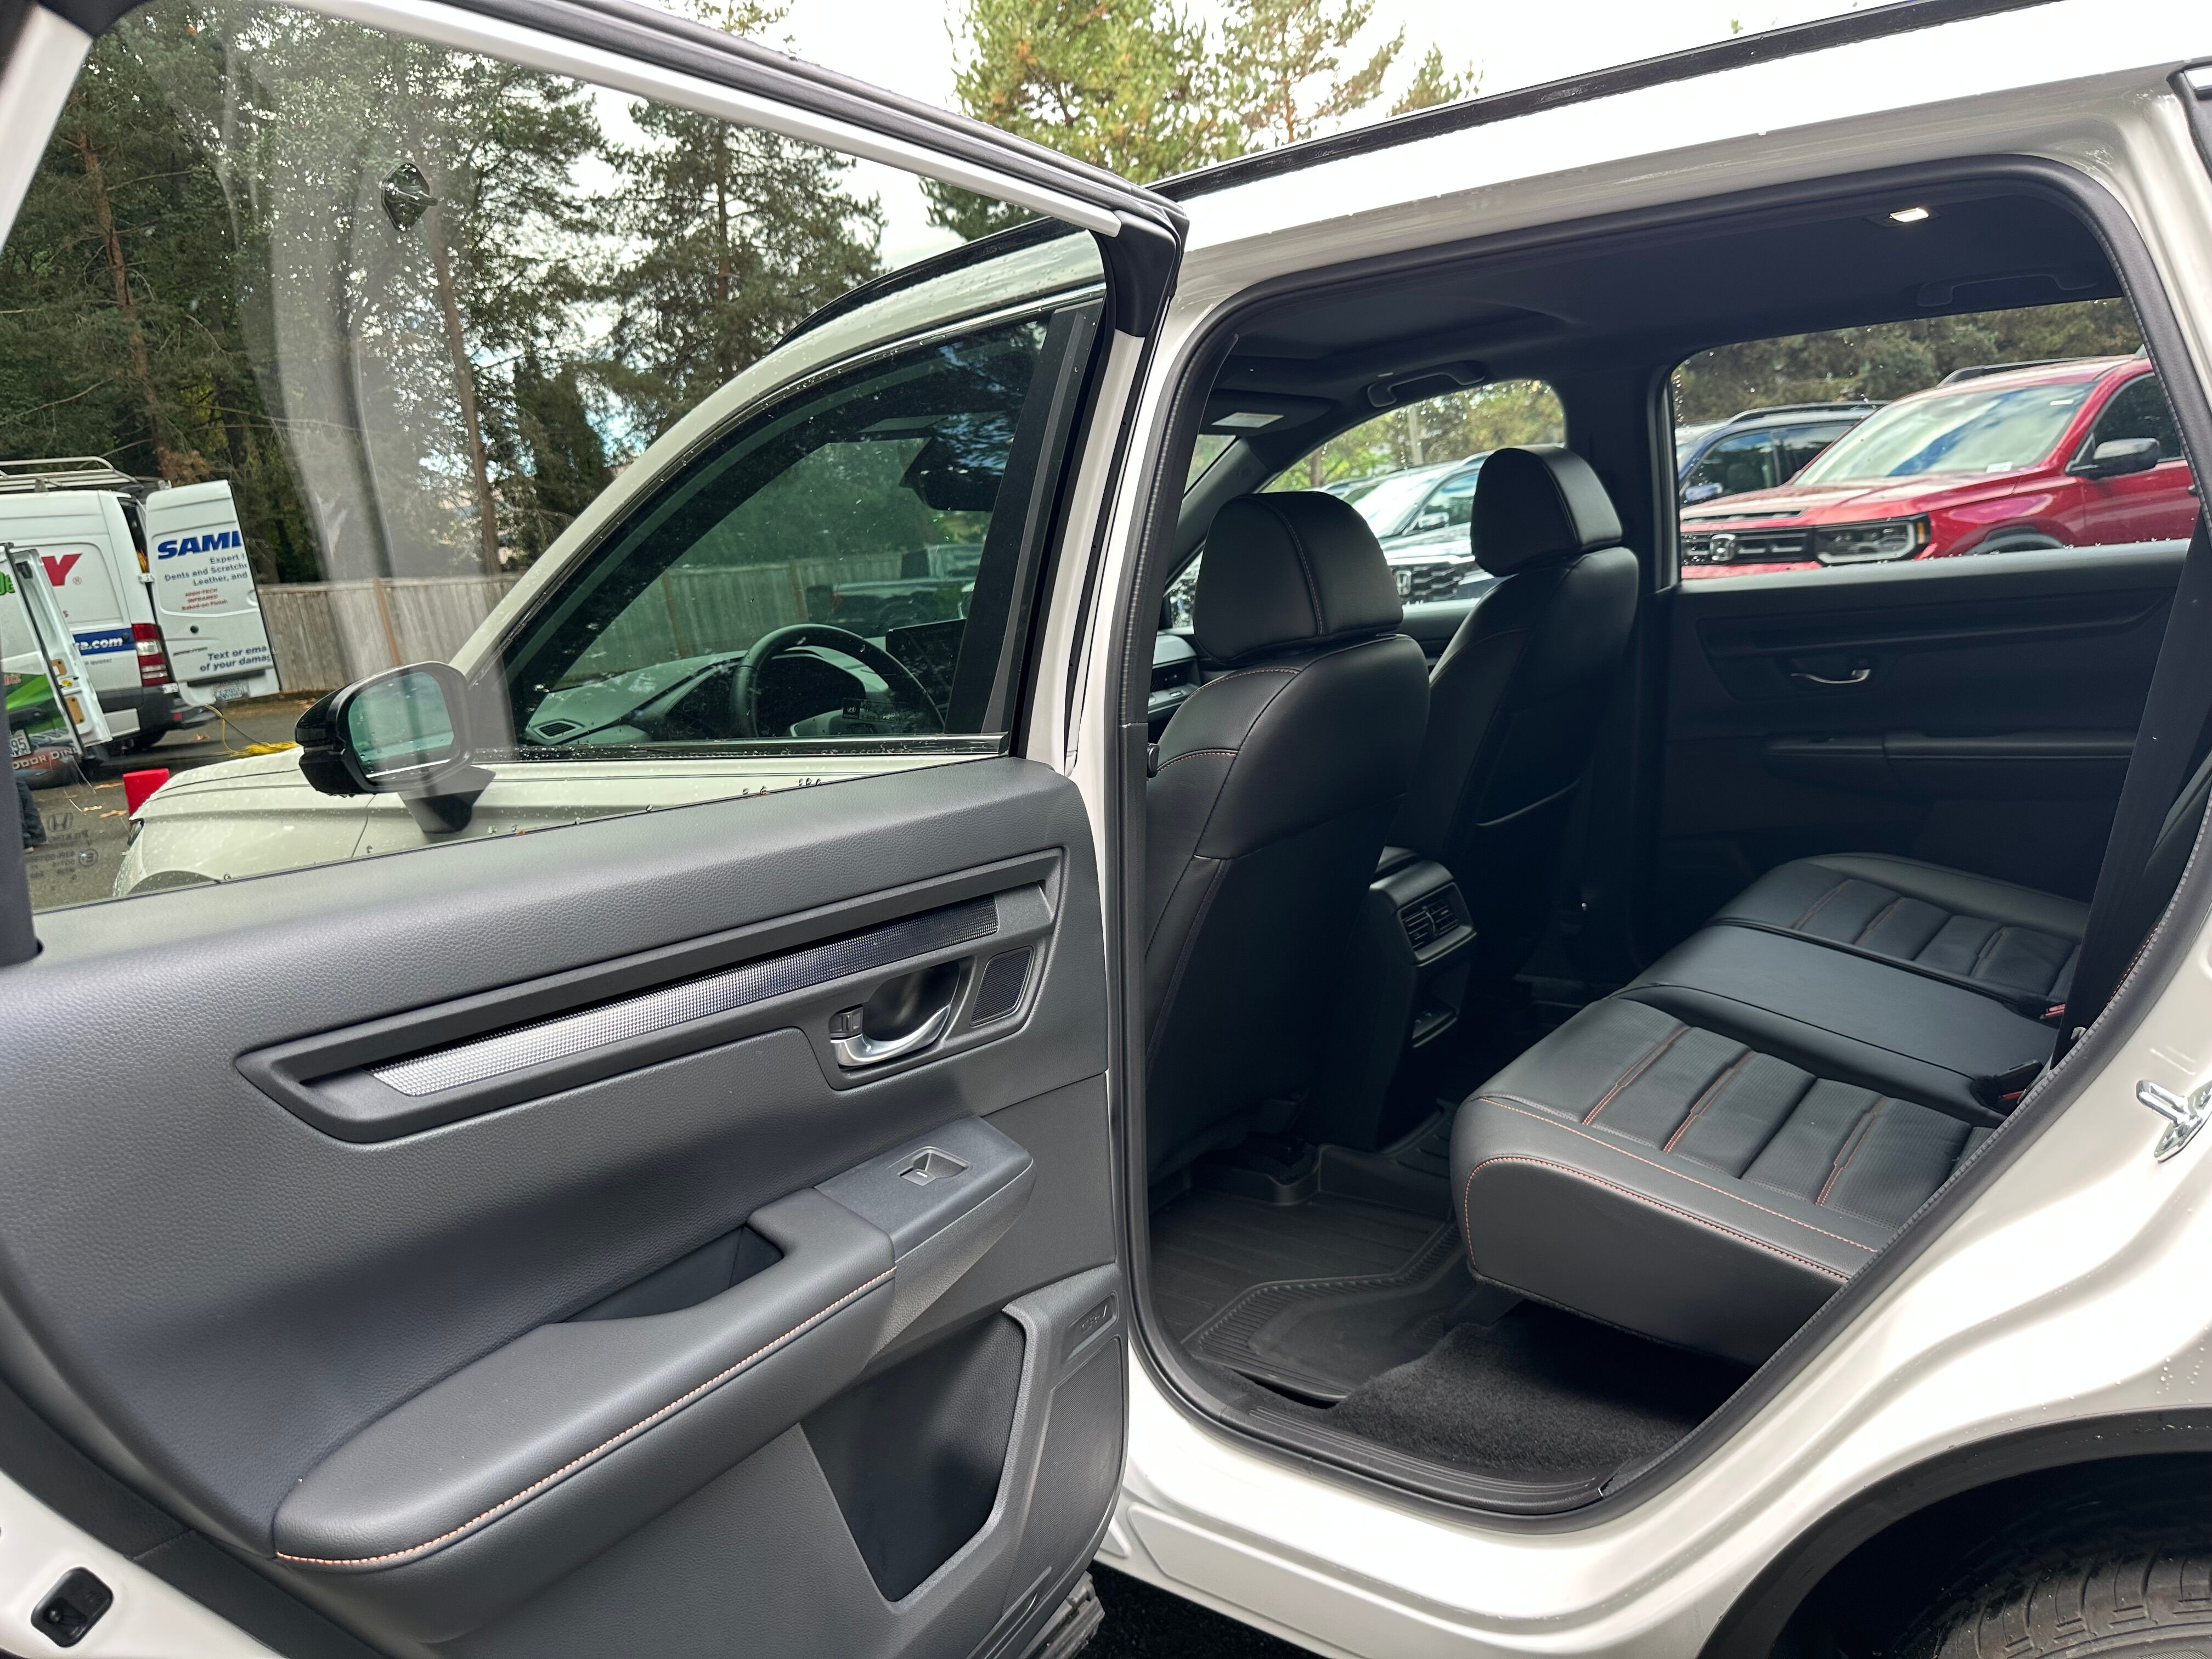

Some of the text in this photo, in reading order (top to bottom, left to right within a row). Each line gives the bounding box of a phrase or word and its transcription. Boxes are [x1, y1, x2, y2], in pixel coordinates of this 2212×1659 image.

[210, 554, 239, 564] Expert
[41, 554, 82, 586] Y
[165, 572, 189, 582] Dents
[193, 567, 208, 576] and
[193, 571, 248, 586] Leather, and
[208, 652, 229, 661] Text
[200, 663, 211, 672] of
[214, 660, 236, 672] your
